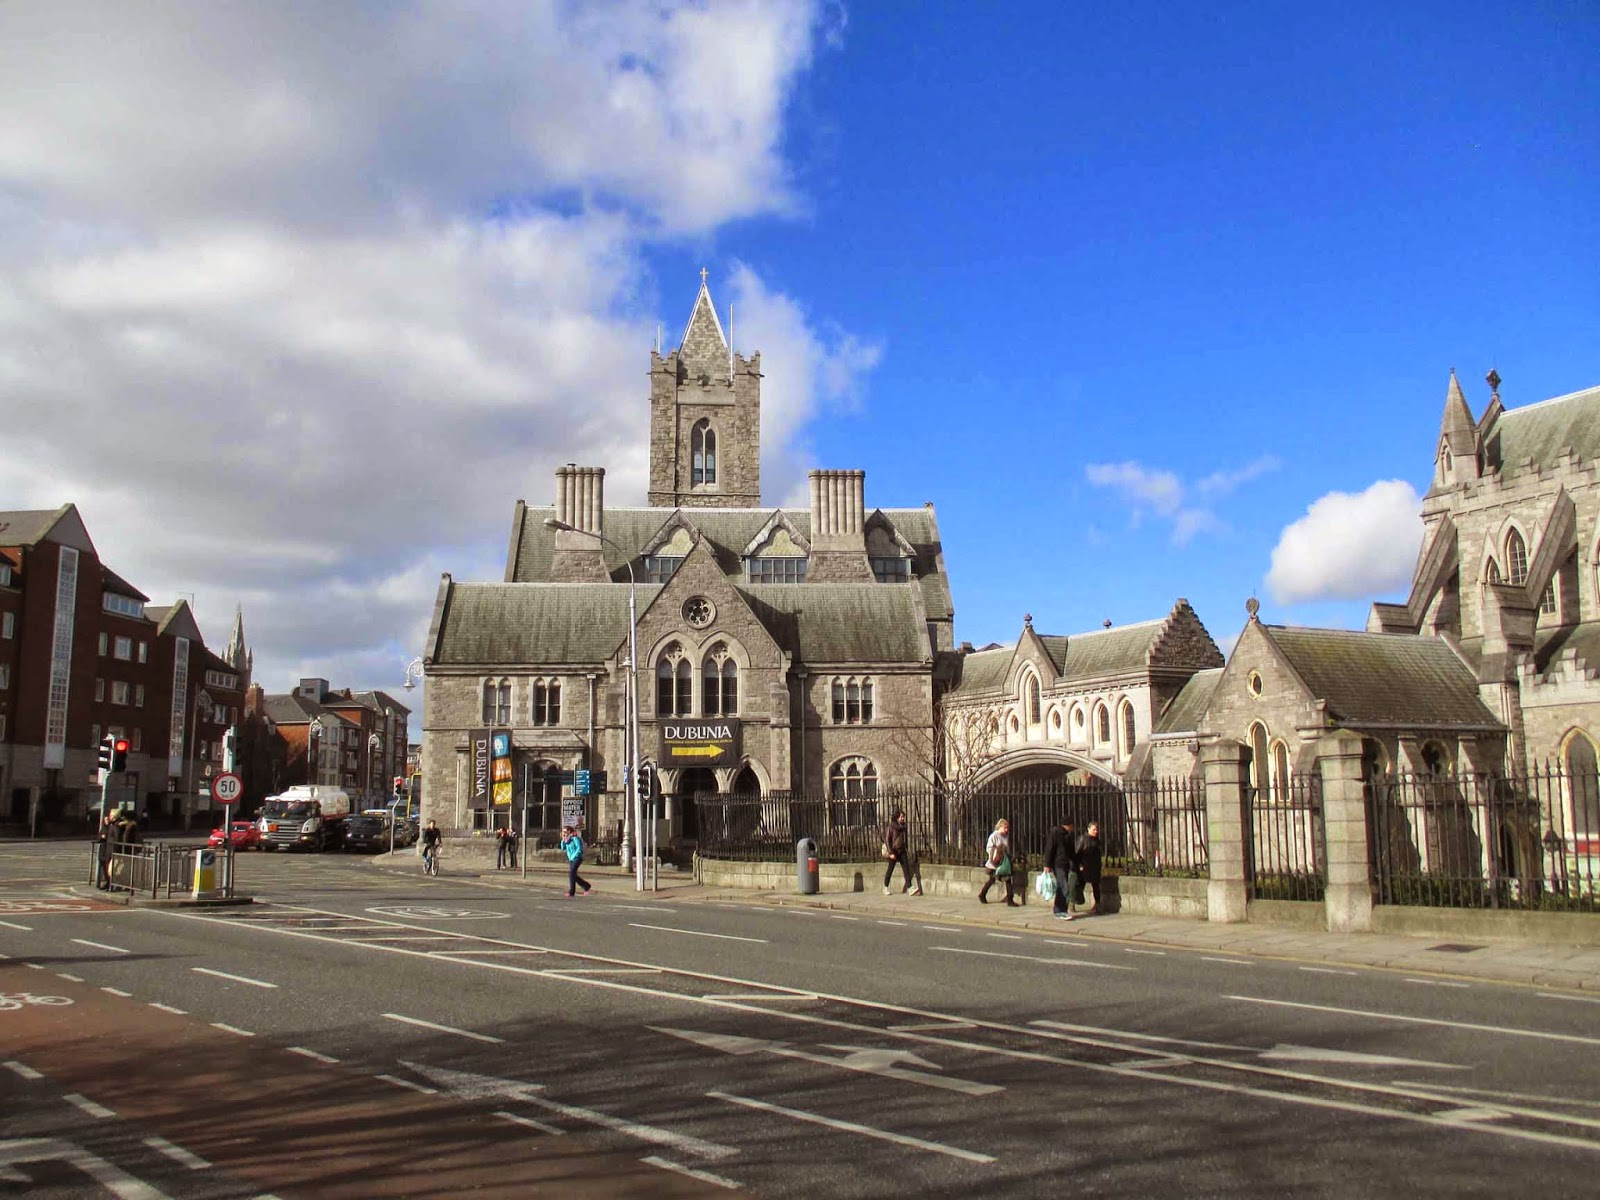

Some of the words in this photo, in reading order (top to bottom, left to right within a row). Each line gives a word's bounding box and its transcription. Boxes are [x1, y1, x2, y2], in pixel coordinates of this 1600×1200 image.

[664, 726, 732, 739] DUBLINIA
[476, 739, 487, 796] DUBLINIA
[221, 780, 236, 793] 50
